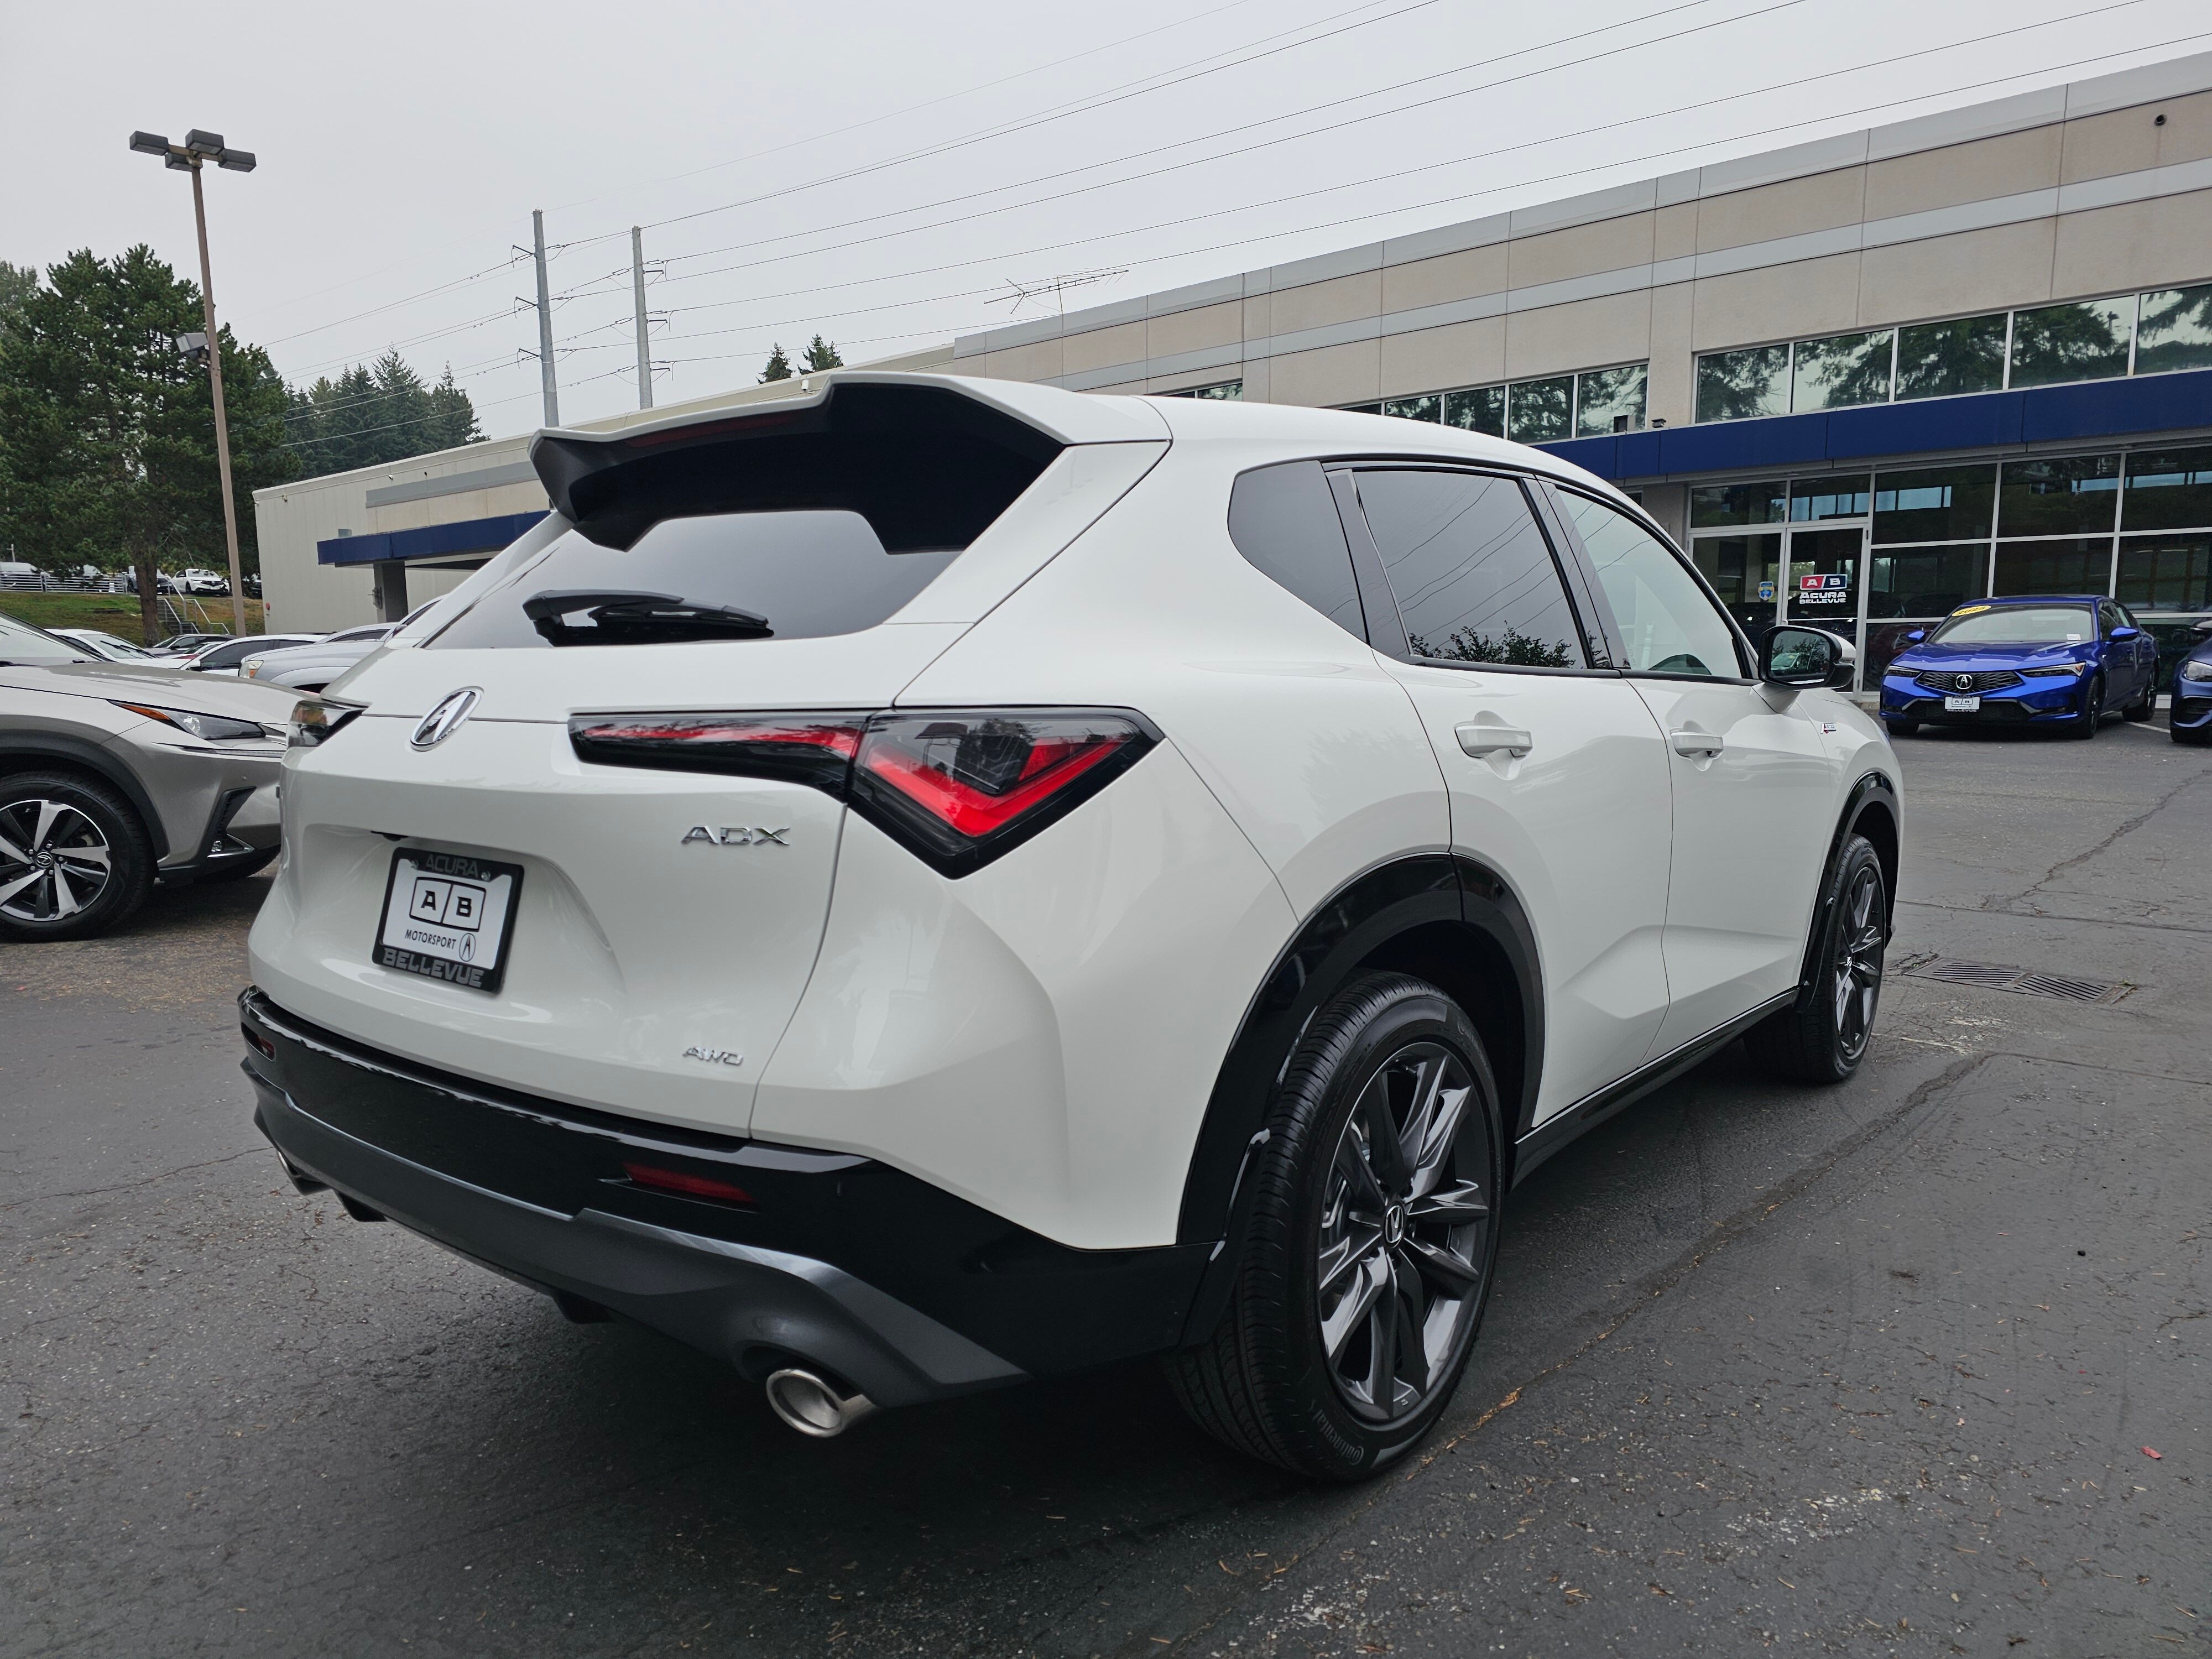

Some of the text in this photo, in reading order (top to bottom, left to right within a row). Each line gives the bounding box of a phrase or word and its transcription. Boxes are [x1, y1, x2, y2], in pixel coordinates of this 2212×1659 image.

[681, 825, 791, 846] ADX
[425, 854, 479, 878] ACURA
[421, 890, 472, 917] A B
[404, 929, 457, 950] MOTORSPORT
[382, 947, 484, 988] BELLEVUE
[682, 1046, 744, 1066] AWD
